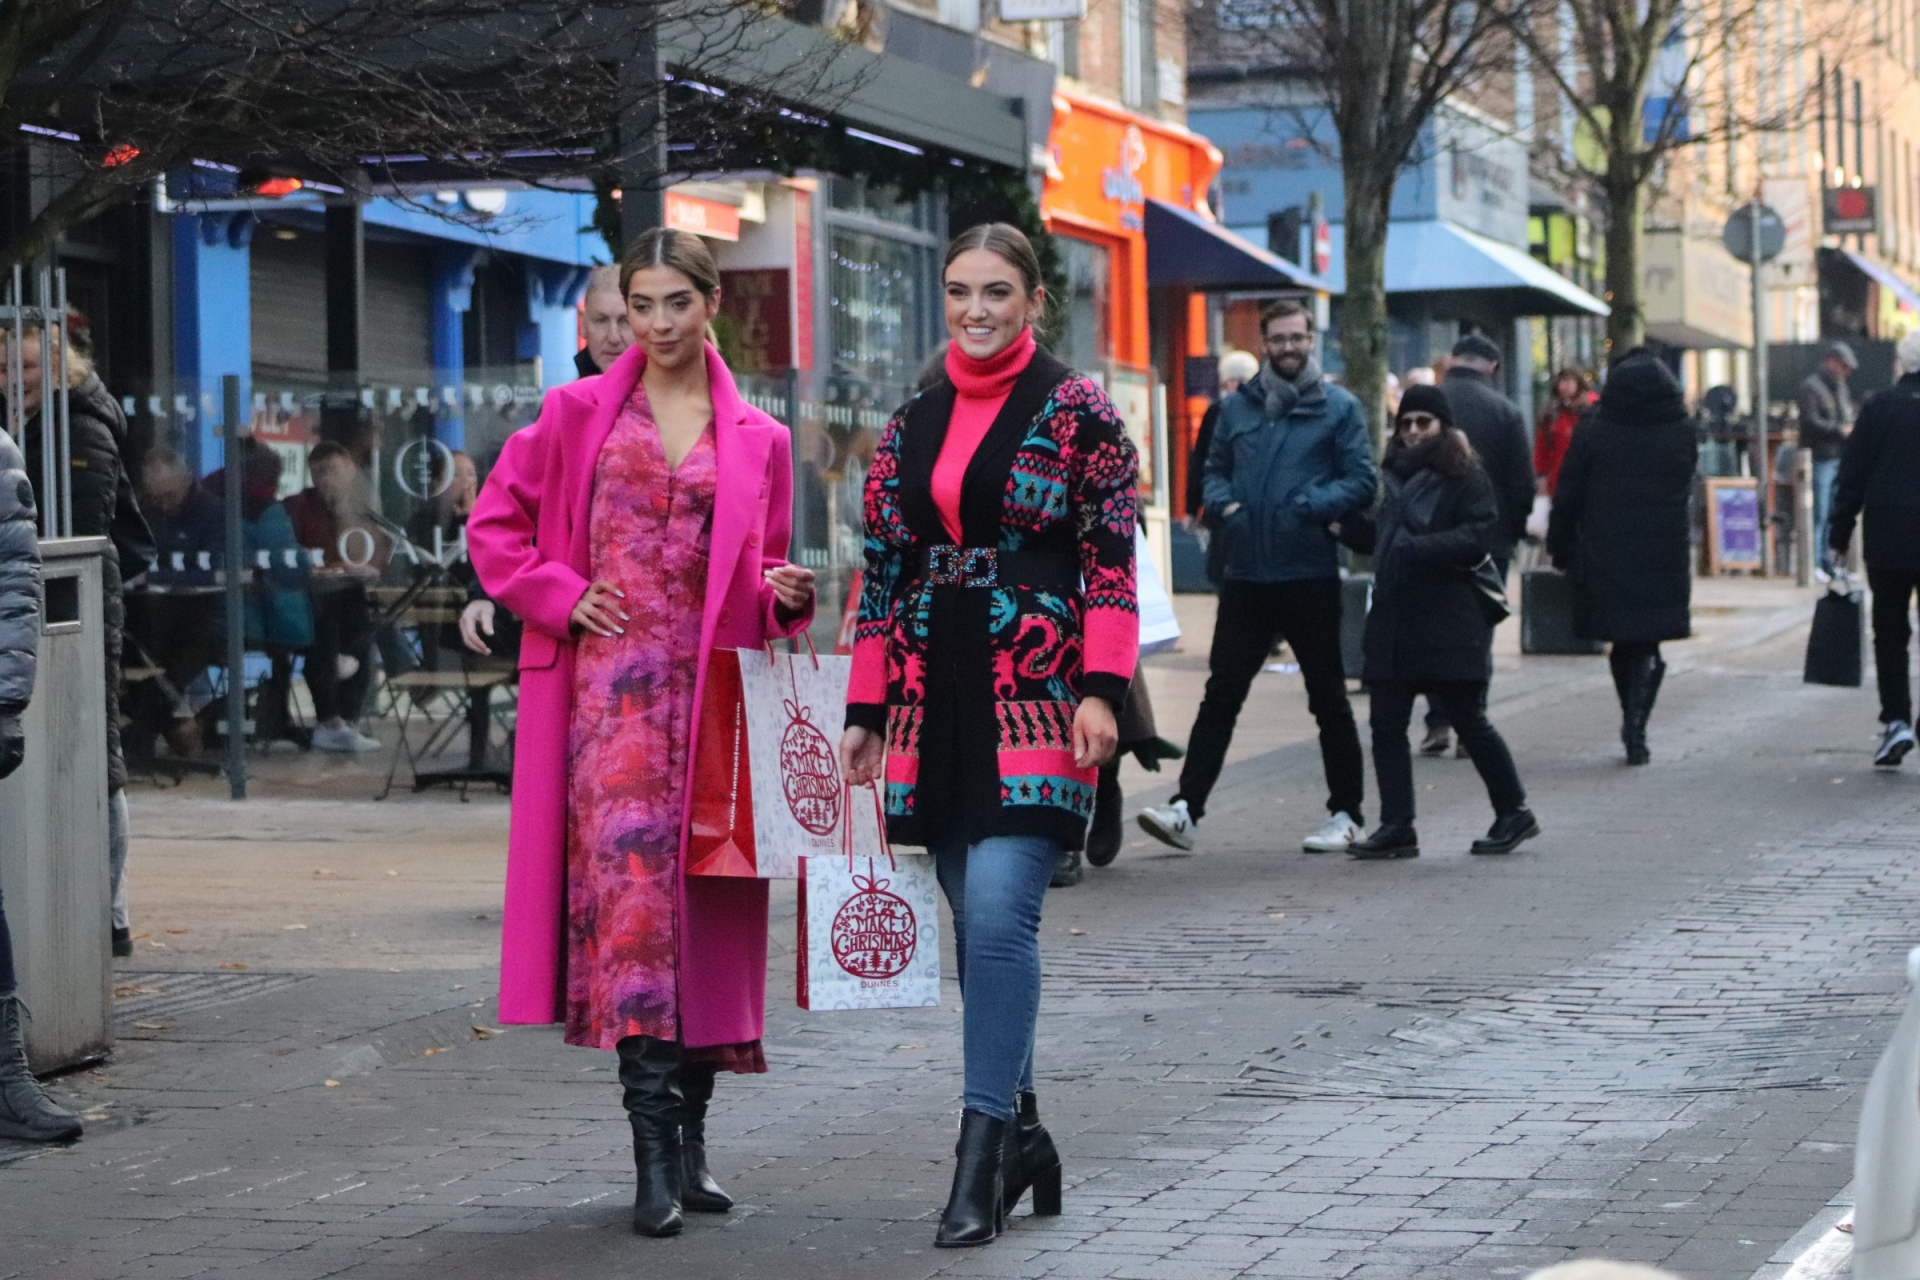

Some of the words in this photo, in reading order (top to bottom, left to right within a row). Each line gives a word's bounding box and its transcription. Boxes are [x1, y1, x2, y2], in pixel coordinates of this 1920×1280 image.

[794, 750, 835, 778] MAKE
[786, 774, 839, 803] CHRISTMAS
[811, 838, 835, 848] DUNNES
[849, 912, 913, 935] MAKE
[836, 932, 915, 956] CHRISTMAS
[860, 979, 899, 989] DUNNES
